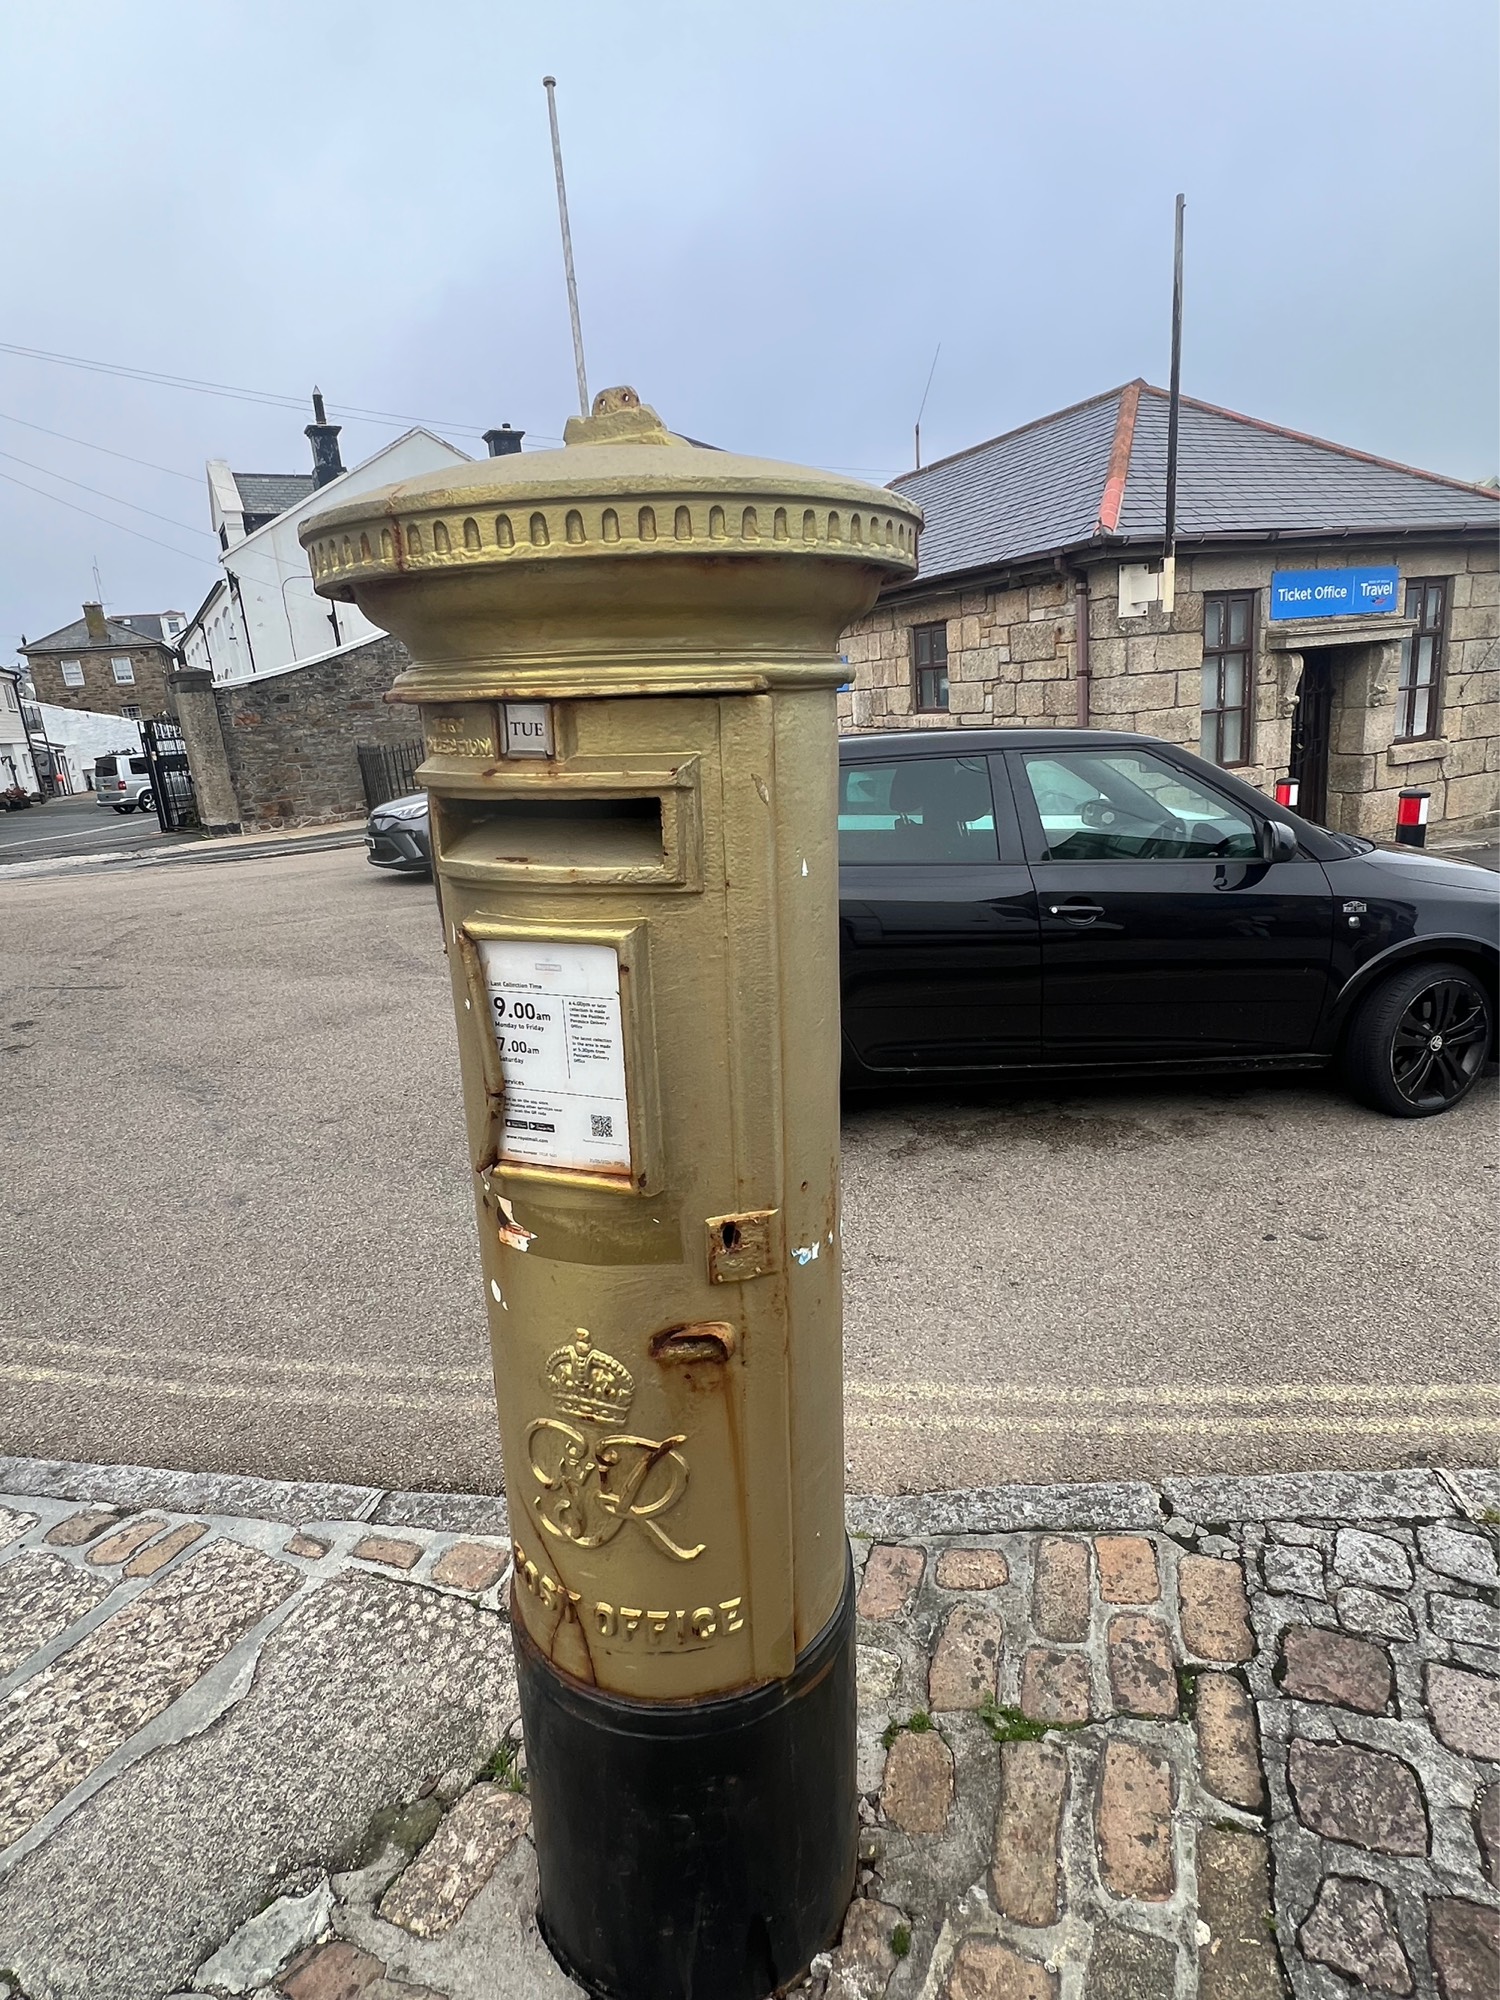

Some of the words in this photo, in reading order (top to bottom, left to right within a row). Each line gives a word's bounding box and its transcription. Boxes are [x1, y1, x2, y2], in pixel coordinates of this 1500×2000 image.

[1278, 587, 1311, 602] Ticket
[1314, 585, 1348, 600] Office
[1360, 581, 1393, 597] Travel
[509, 721, 545, 737] TUE
[502, 981, 528, 989] Collection
[493, 996, 551, 1022] 9.00am
[494, 1021, 517, 1030] Monday
[526, 1023, 545, 1032] Friday
[496, 1036, 540, 1055] 7.00am
[593, 1596, 745, 1647] OFFICE
